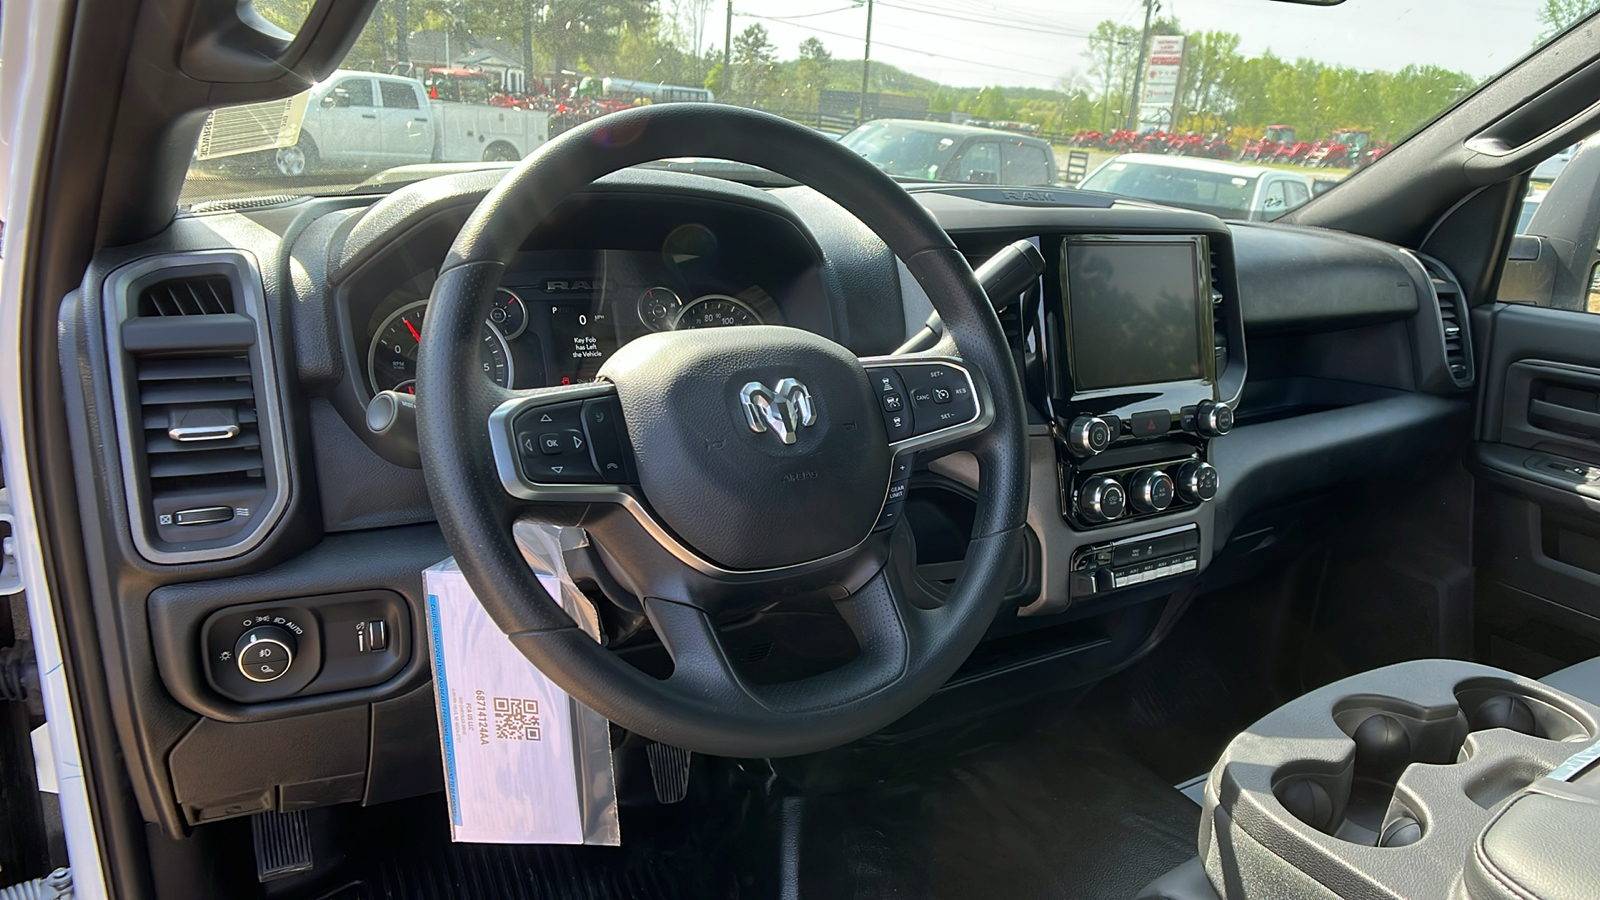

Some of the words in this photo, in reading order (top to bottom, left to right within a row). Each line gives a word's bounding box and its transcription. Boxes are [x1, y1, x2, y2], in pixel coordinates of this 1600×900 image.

[1002, 191, 1056, 202] RAM
[578, 314, 587, 326] 0
[704, 313, 714, 322] 80
[721, 317, 735, 325] 100
[394, 344, 402, 354] 0
[582, 350, 603, 358] Vehicle
[483, 363, 491, 371] 5
[546, 439, 558, 448] OK
[782, 470, 820, 483] AIRBAG
[890, 485, 905, 493] GEAR
[285, 621, 304, 635] AUTO
[434, 630, 442, 676] TRANSPORTATION
[475, 690, 489, 745] 68714124AA
